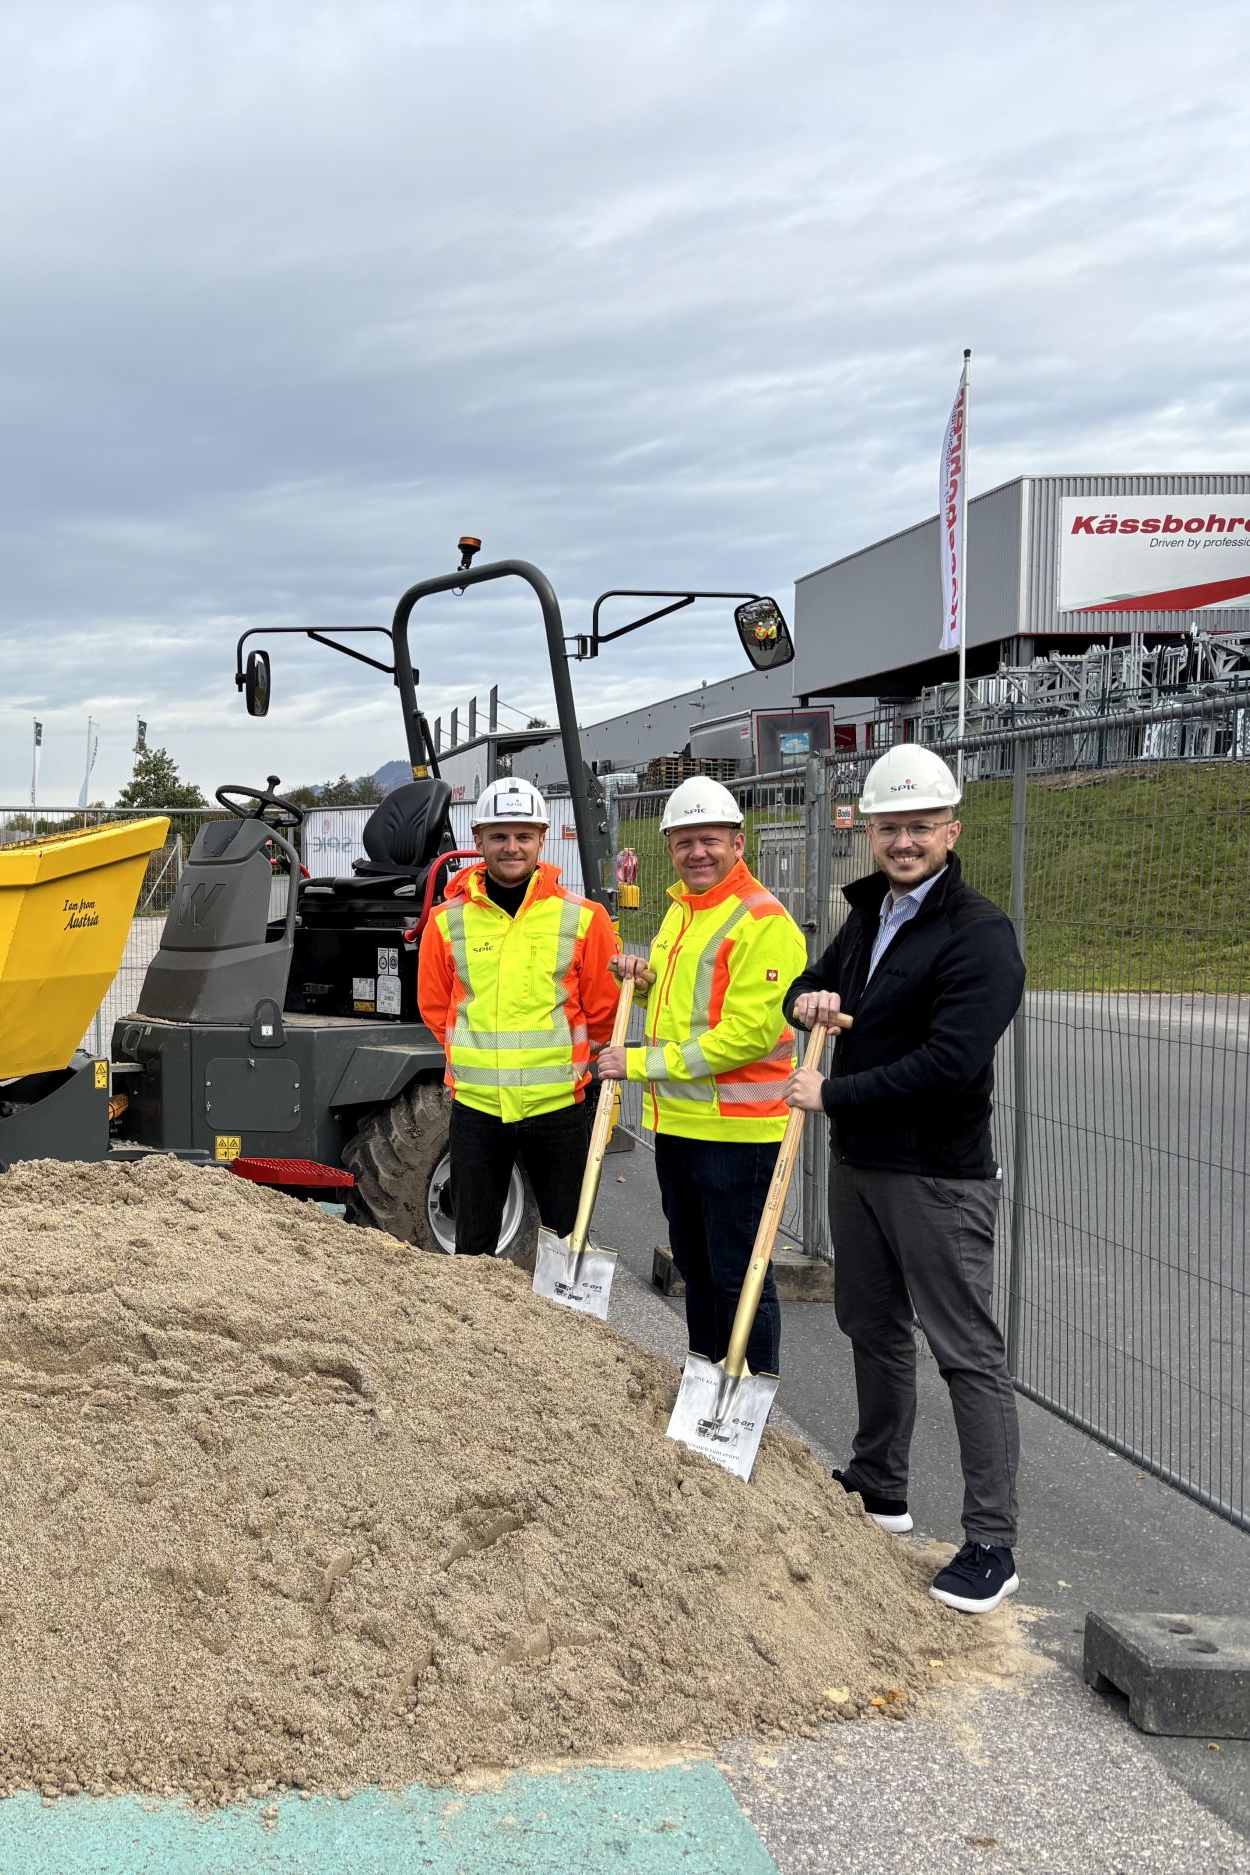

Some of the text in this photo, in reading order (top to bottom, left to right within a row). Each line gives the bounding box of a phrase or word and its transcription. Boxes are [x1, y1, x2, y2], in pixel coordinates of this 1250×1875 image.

[1150, 537, 1184, 547] Driven
[1187, 537, 1201, 549] by
[62, 898, 95, 913] I am from
[63, 911, 99, 931] Austria
